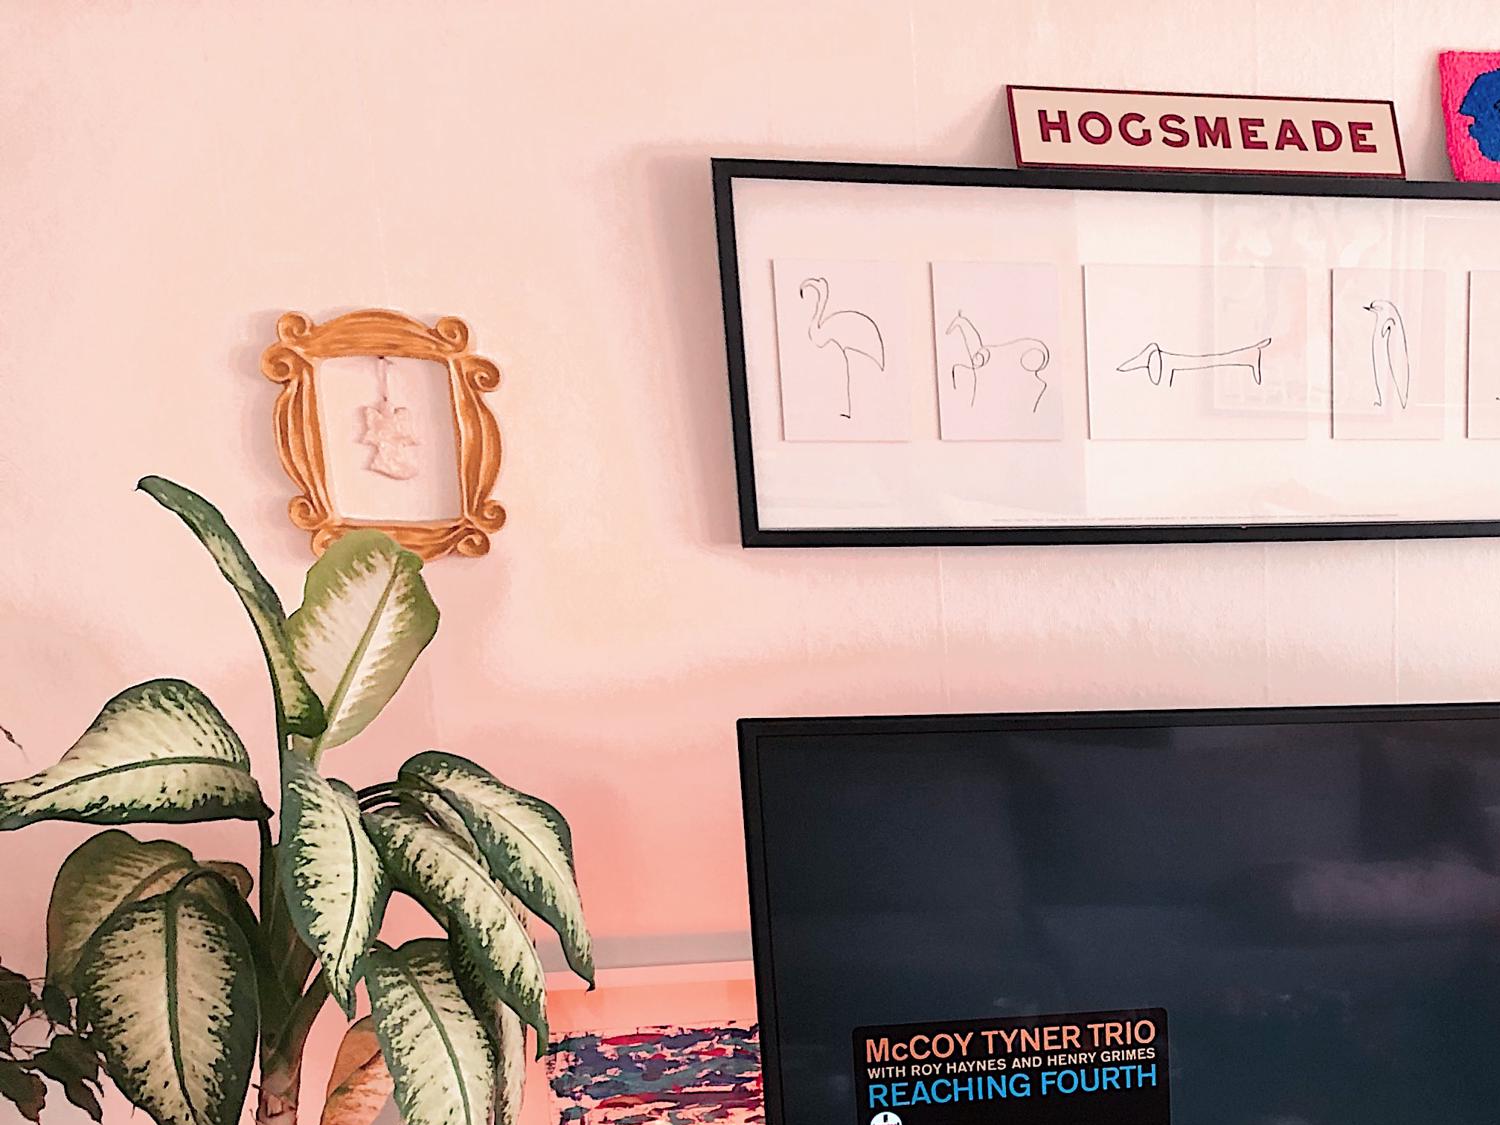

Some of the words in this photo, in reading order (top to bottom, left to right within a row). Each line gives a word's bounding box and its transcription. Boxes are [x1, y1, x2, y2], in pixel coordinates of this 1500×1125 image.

[1036, 108, 1379, 154] HOGSMEADE
[866, 1032, 974, 1063] McCOY
[981, 1026, 1081, 1054] TYNER
[1087, 1019, 1156, 1047] TRIO
[867, 1065, 906, 1080] WITH
[911, 1063, 942, 1077] ROY
[946, 1058, 1007, 1074] HAYNES
[1011, 1055, 1042, 1069] AND
[1047, 1051, 1097, 1067] HENRY
[1100, 1047, 1156, 1062] GRIMES
[868, 1074, 1031, 1109] REACHING
[1040, 1063, 1157, 1095] FOURTH
